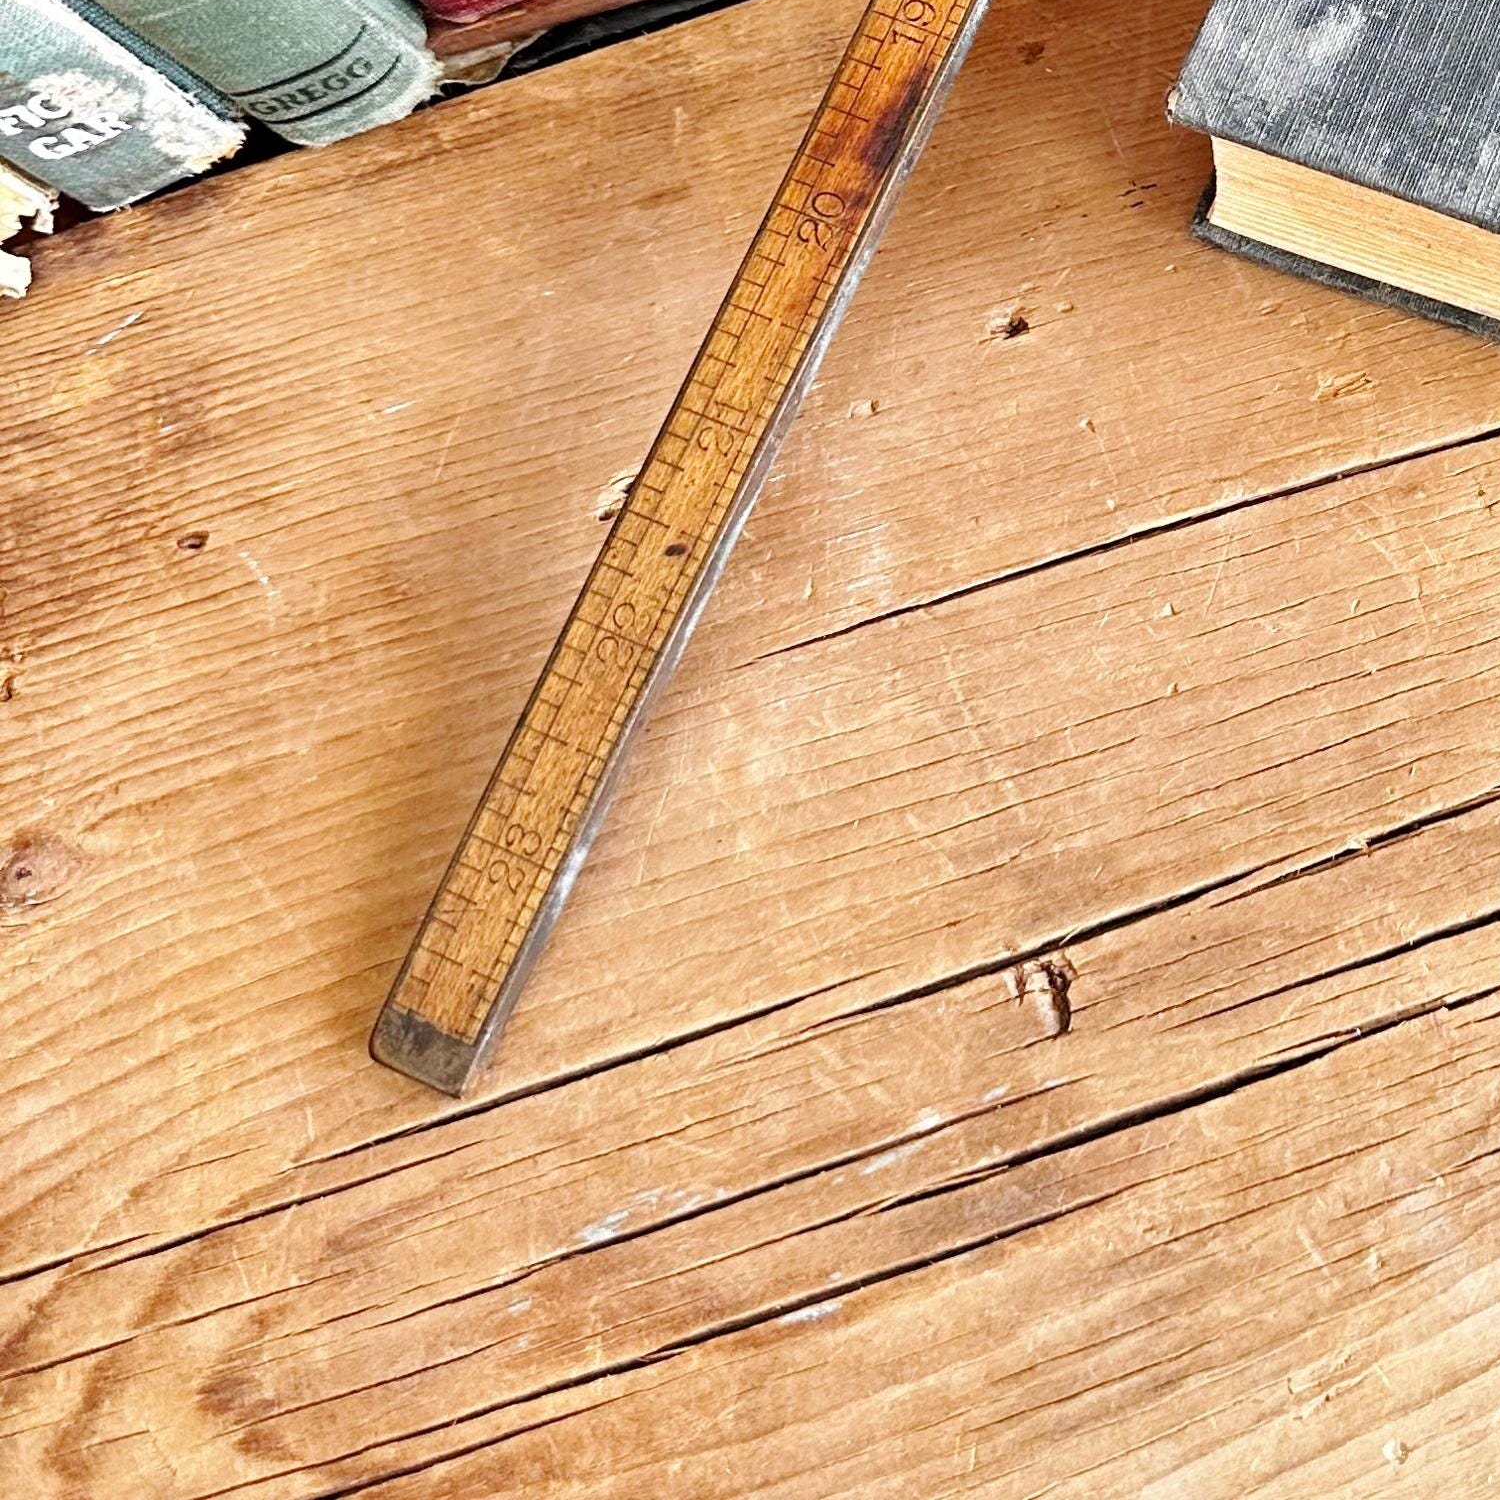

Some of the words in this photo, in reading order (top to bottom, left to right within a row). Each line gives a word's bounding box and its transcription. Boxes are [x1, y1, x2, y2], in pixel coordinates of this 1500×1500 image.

[248, 56, 374, 116] GREGG
[797, 191, 846, 251] 20
[697, 400, 748, 457] 21
[596, 601, 651, 671] 22
[488, 822, 542, 895] 23
